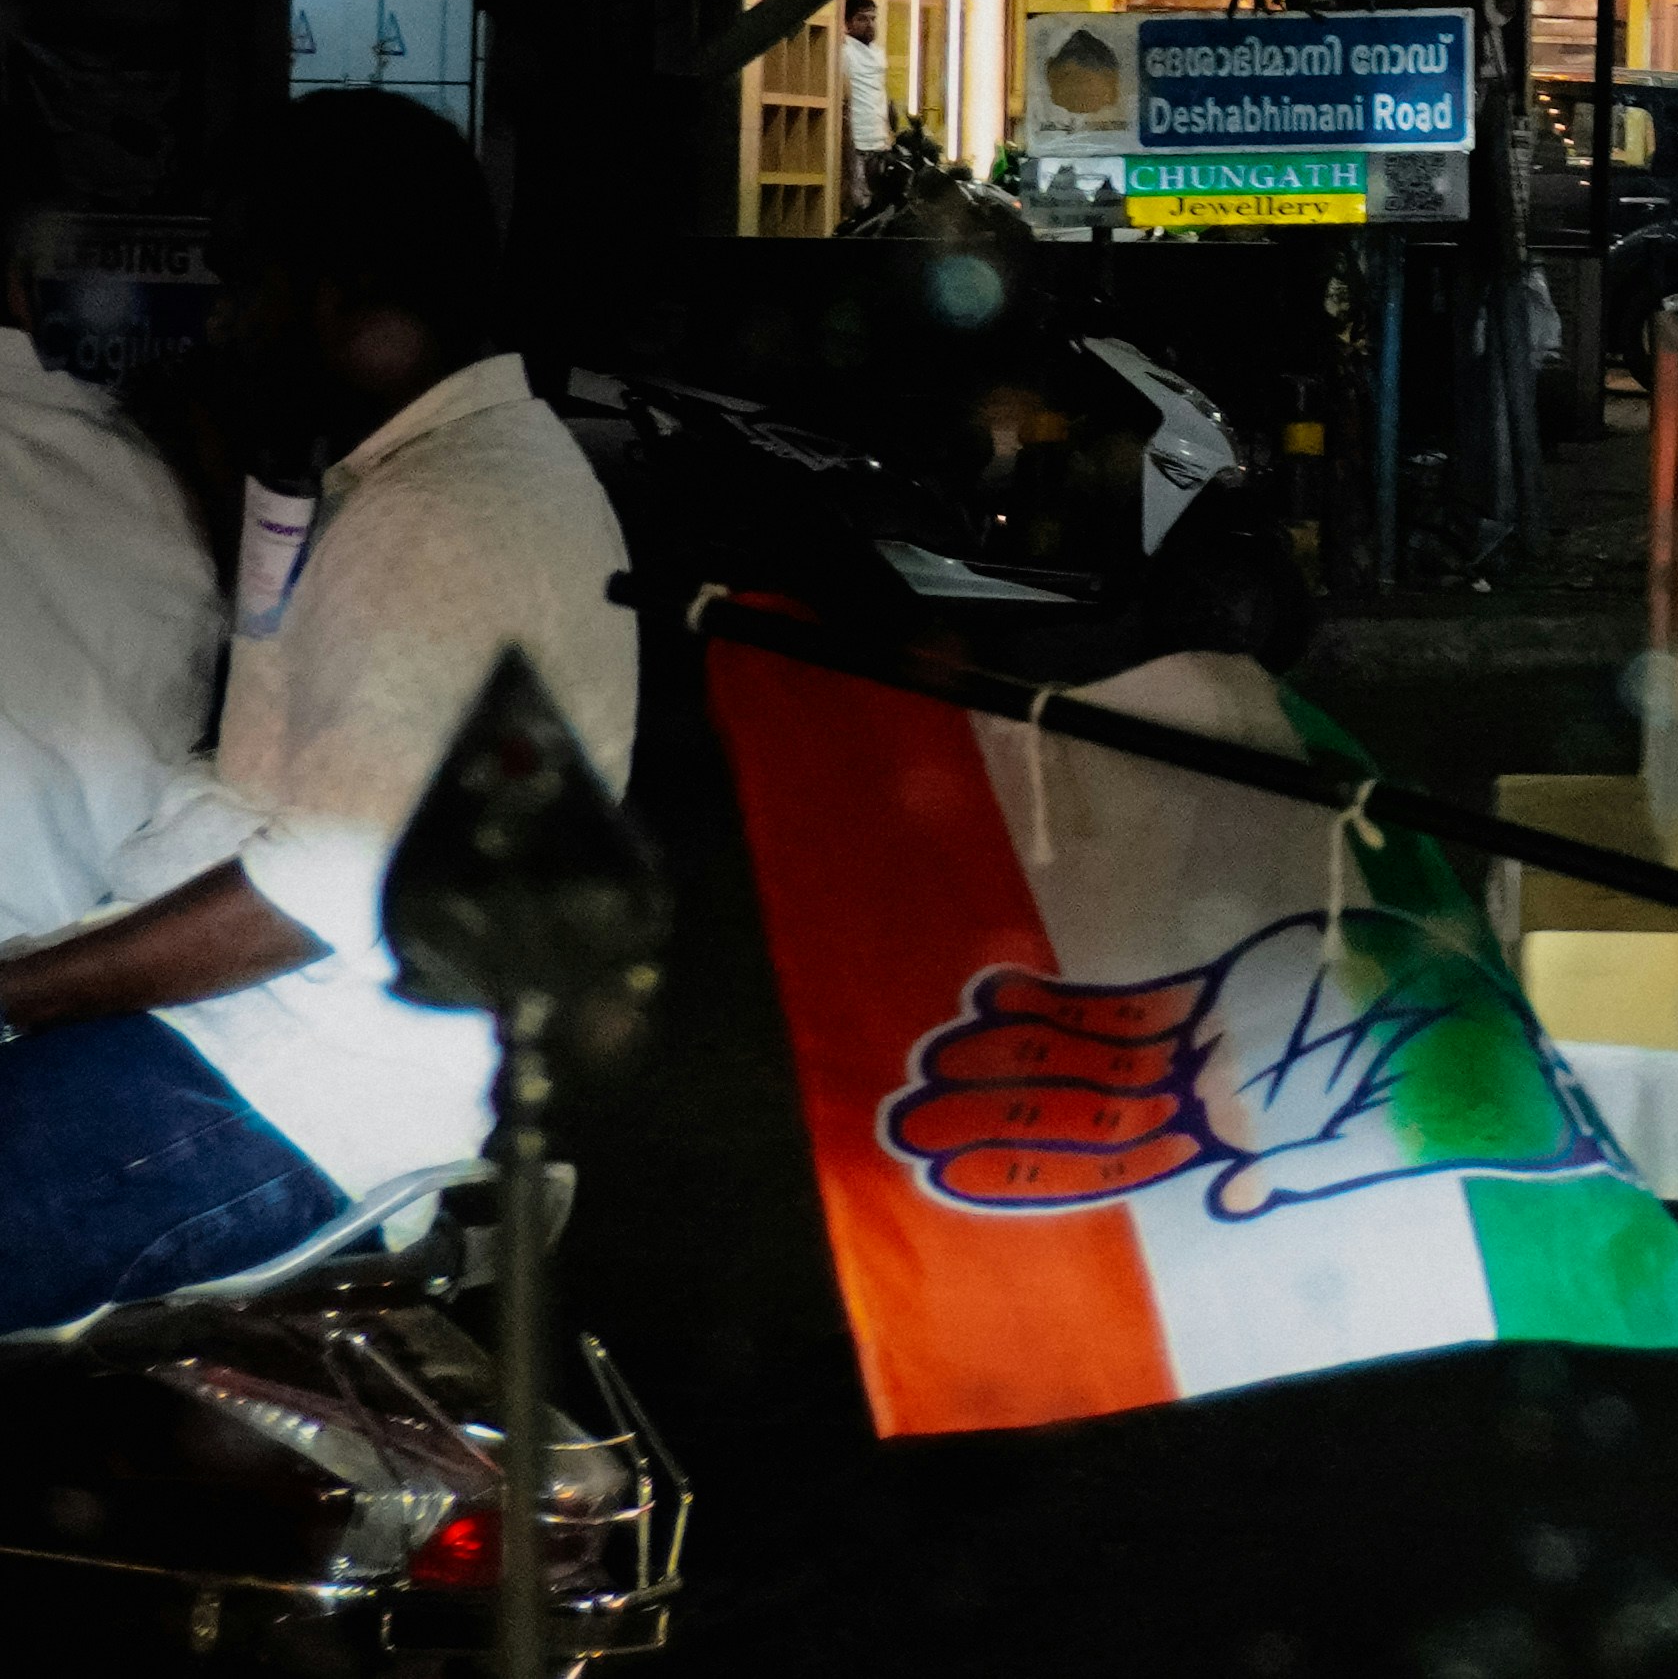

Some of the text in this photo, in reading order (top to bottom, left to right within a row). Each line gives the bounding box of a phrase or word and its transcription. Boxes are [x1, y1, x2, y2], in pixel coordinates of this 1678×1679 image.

[1149, 90, 1454, 135] Deshabhimani Road
[1128, 162, 1361, 192] CHUNGATH
[1168, 194, 1331, 220] Jewellery
